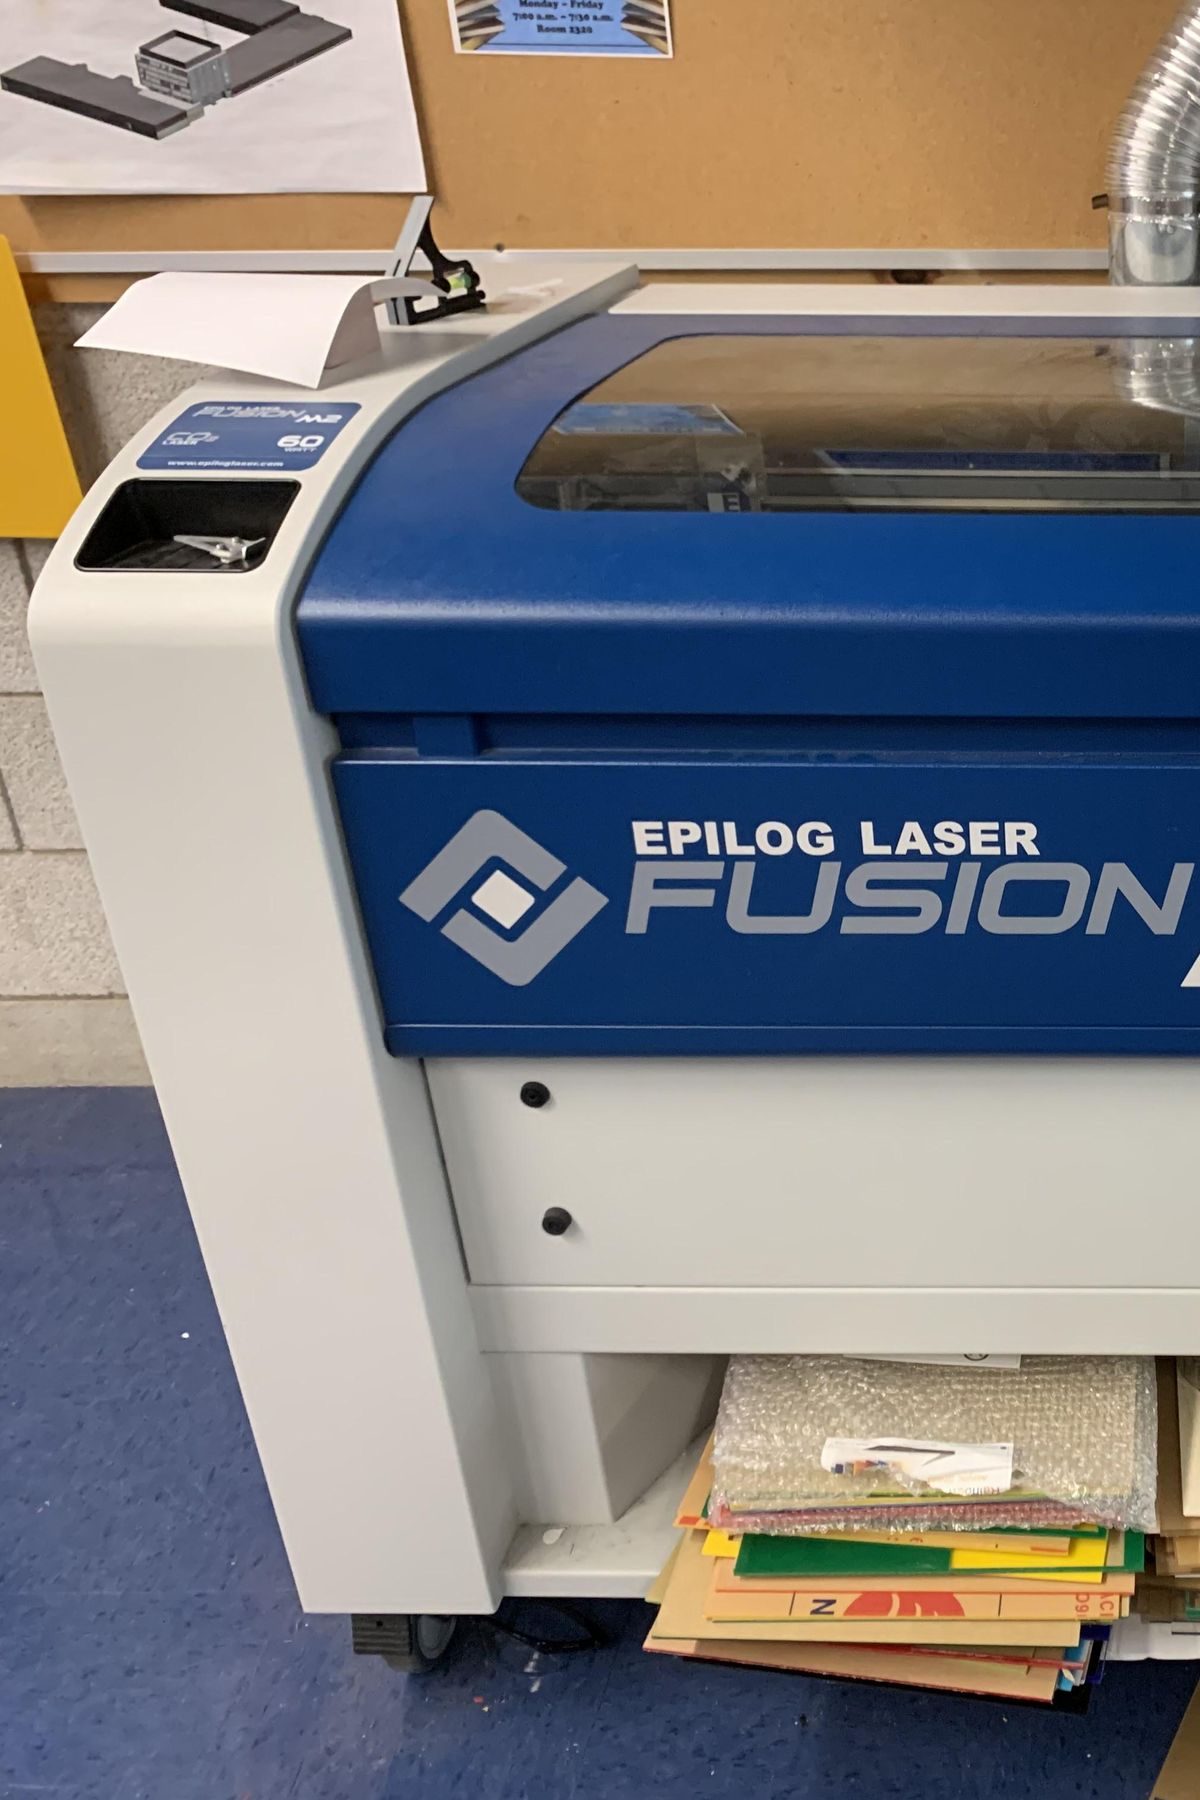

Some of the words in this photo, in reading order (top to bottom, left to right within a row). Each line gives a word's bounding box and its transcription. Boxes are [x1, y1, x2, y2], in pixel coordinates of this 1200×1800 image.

[519, 0, 559, 9] Monday
[570, 0, 604, 9] Friday
[512, 13, 534, 21] 7:00
[568, 13, 590, 22] 7:30
[537, 24, 567, 33] Room
[193, 408, 306, 418] FUSION
[277, 435, 324, 448] 60
[168, 460, 284, 468] www.epiloglaser.com
[631, 820, 834, 856] EPILOG
[860, 820, 1041, 856] LASER
[625, 861, 1195, 935] FUSION
